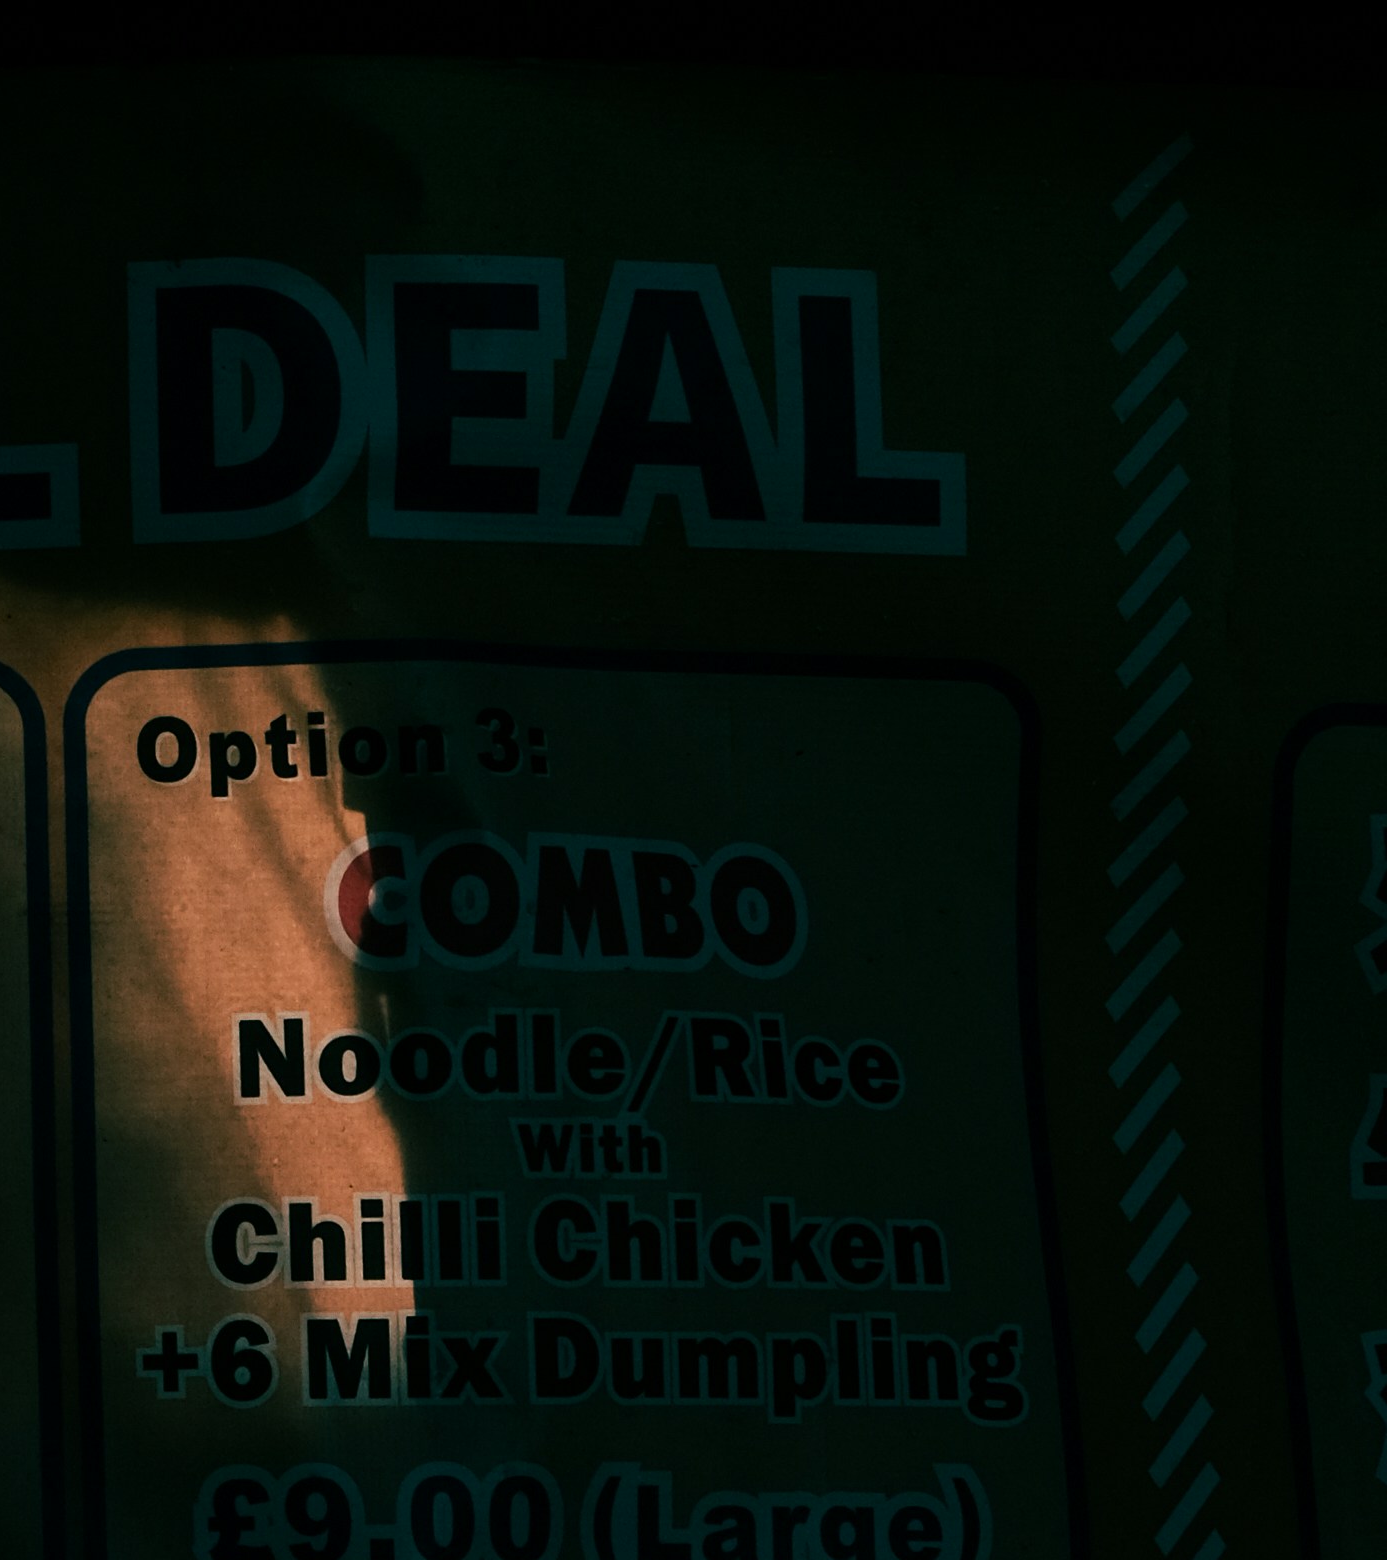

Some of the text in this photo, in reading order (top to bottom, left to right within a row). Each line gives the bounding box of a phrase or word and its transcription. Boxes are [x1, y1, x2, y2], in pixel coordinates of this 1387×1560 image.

[146, 270, 952, 537] DEAL
[134, 705, 552, 801] Option 3:
[330, 837, 804, 973] COMBO
[236, 1010, 906, 1116] Noodle/Rice
[515, 1120, 665, 1177] With
[209, 1196, 951, 1287] Chilli Chicken
[137, 1311, 1026, 1423] +6 Mix Dumpling
